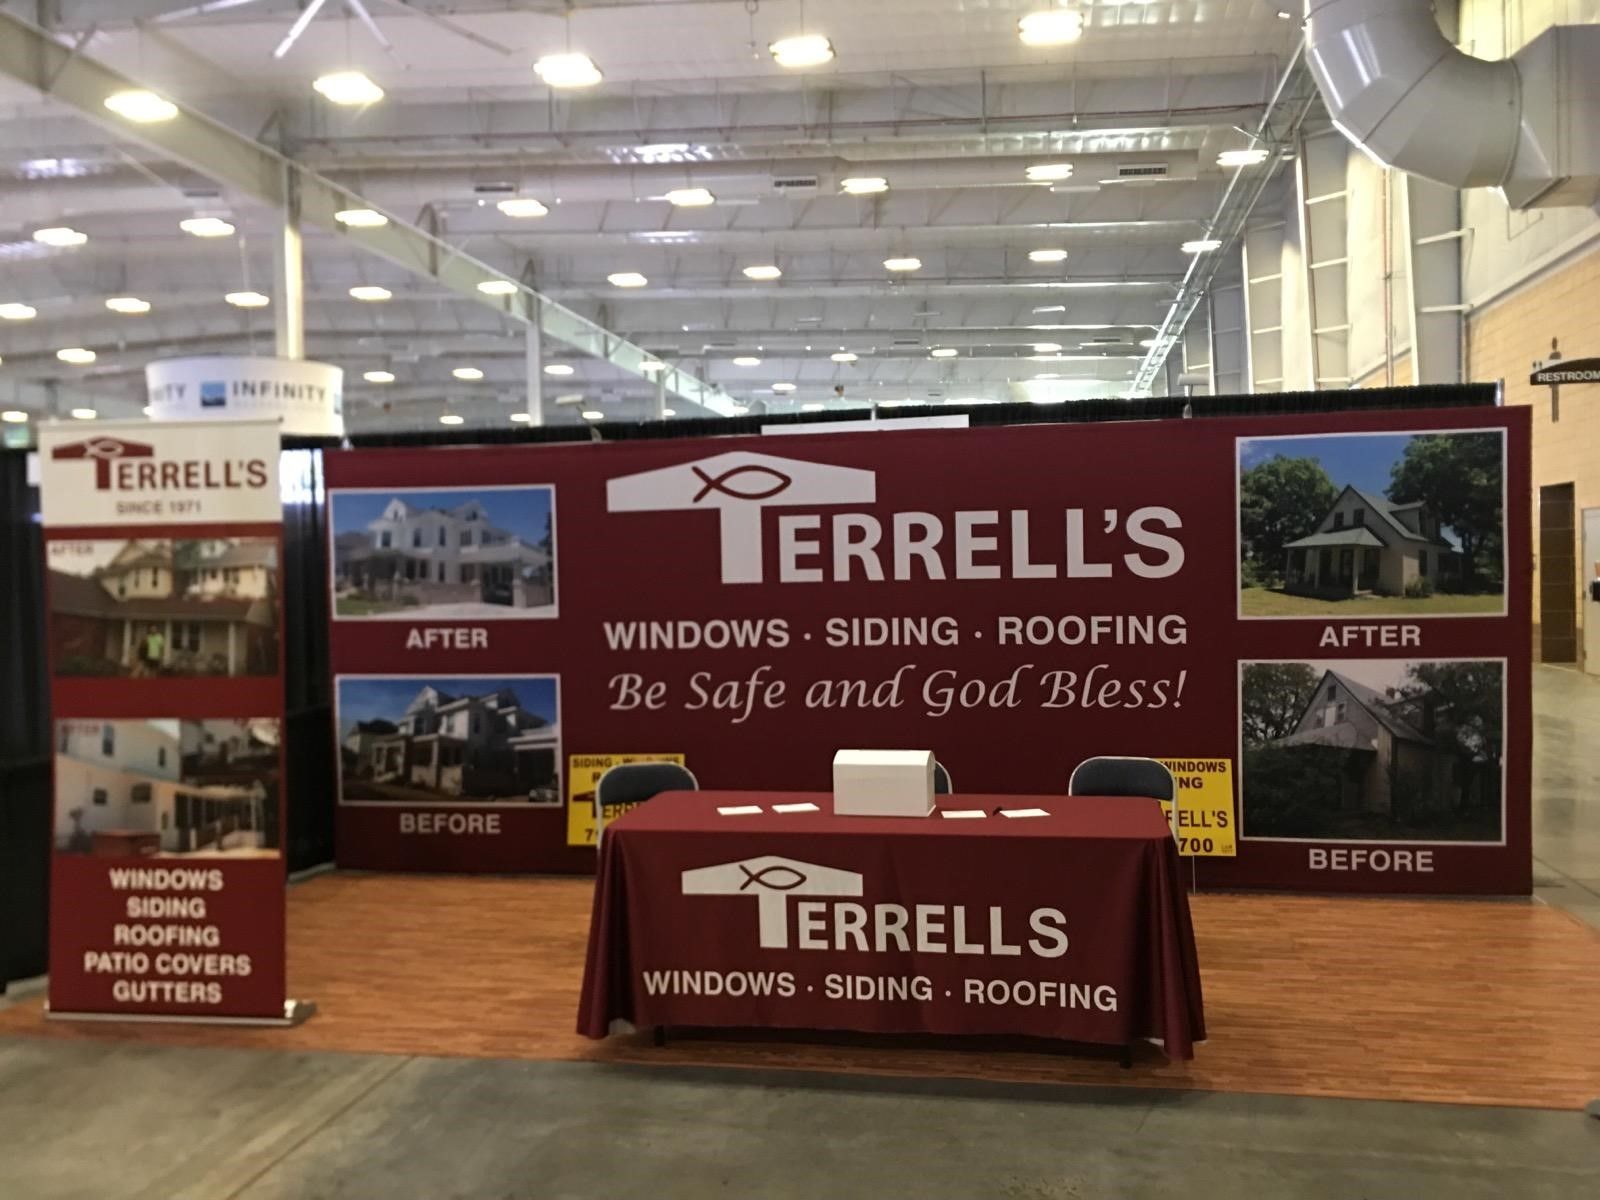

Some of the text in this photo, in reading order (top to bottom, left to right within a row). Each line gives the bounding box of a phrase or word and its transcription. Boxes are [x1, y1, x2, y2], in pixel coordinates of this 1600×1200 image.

[231, 380, 326, 400] INFINITY
[52, 437, 268, 490] TERRELL'S
[116, 500, 203, 515] SINCE 1971
[607, 450, 1186, 584] TERRELL'S
[406, 627, 489, 649] AFTER
[603, 614, 1188, 650] WINDOWS SIDING ROOFING
[1319, 625, 1422, 647] AFTER
[608, 663, 1188, 724] Be Safe and God Bless!
[572, 757, 613, 769] SIDING
[400, 813, 502, 835] BEFORE
[1308, 848, 1435, 872] BEFORE
[109, 868, 224, 892] WINDOWS
[126, 896, 207, 919] SIDING
[681, 855, 1069, 958] TERRELLS
[114, 924, 220, 947] ROOFING
[84, 951, 252, 976] PATIO COVERS
[112, 981, 222, 1004] GUTTERS
[643, 970, 1118, 1012] WINDOWS SIDING ROOFING
